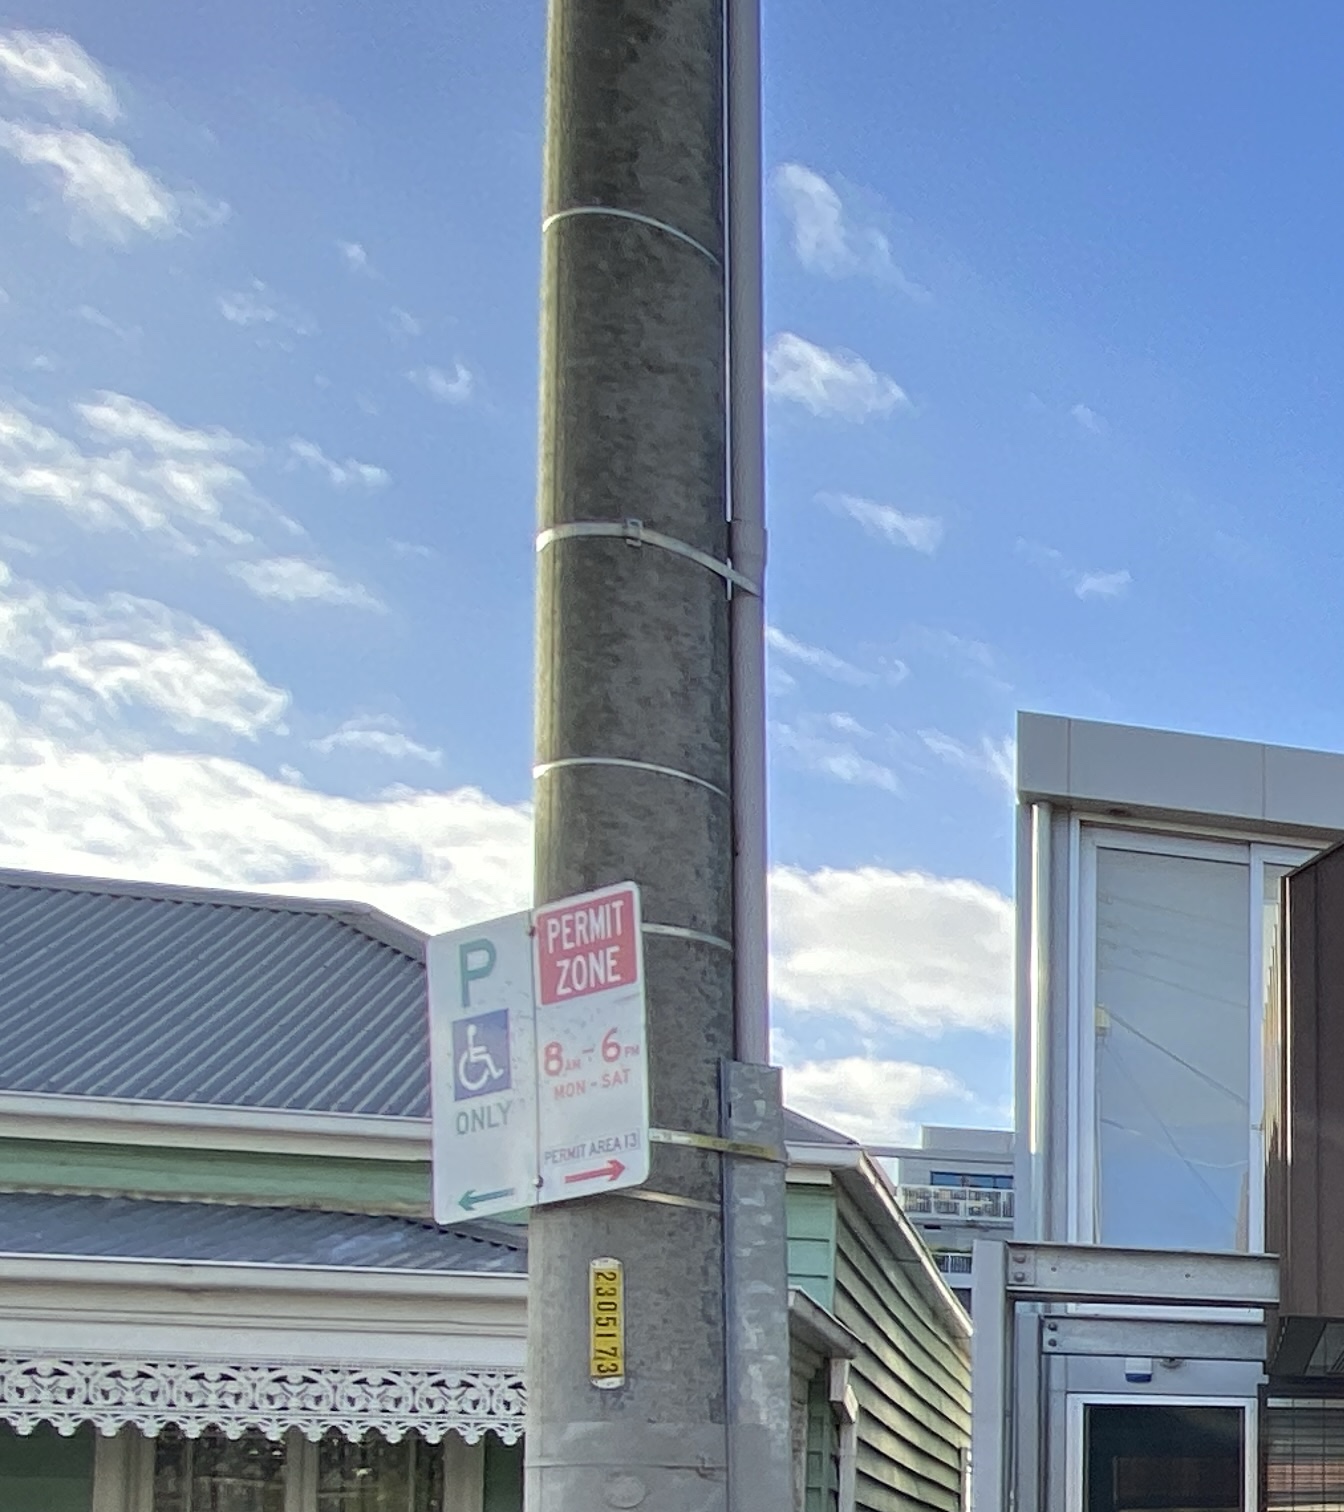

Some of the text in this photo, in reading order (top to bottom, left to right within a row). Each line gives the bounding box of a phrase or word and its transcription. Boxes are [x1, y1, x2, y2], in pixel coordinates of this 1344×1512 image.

[546, 899, 625, 955] PERMIT
[460, 938, 496, 1007] P
[555, 945, 622, 996] ZONE
[554, 1080, 586, 1100] MON
[601, 1068, 631, 1088] SAT
[456, 1102, 512, 1135] ONLY
[544, 1144, 585, 1165] PERMIT
[589, 1137, 622, 1157] AREA
